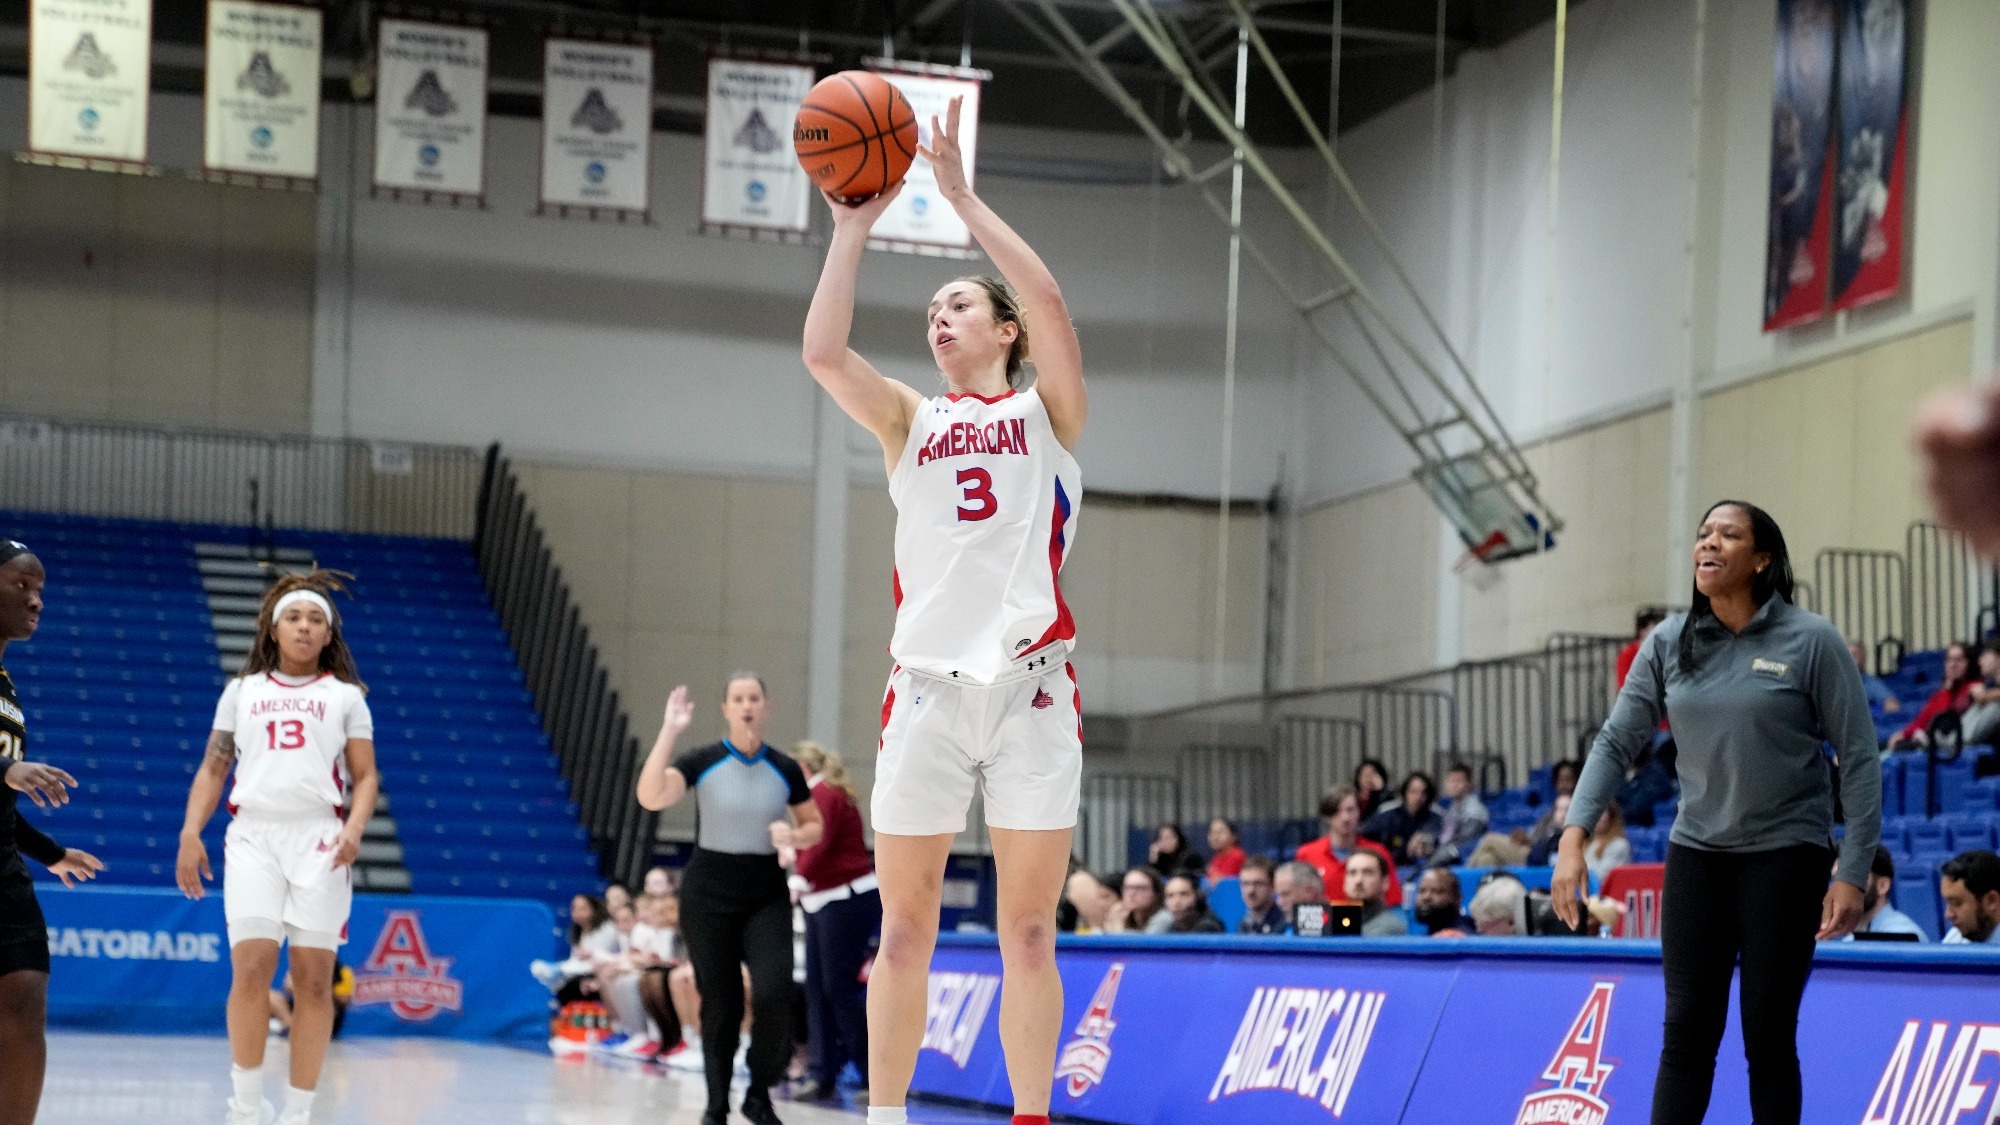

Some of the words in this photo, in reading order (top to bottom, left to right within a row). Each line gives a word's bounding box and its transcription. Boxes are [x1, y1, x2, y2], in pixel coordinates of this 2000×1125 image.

[917, 418, 1029, 467] AMERICAN
[956, 466, 998, 522] 3
[249, 698, 327, 721] AMERICAN
[266, 720, 305, 750] 13
[919, 973, 1001, 1070] ERICAN
[1208, 986, 1388, 1119] AMERICAN
[1519, 1097, 1603, 1125] AMERICAN
